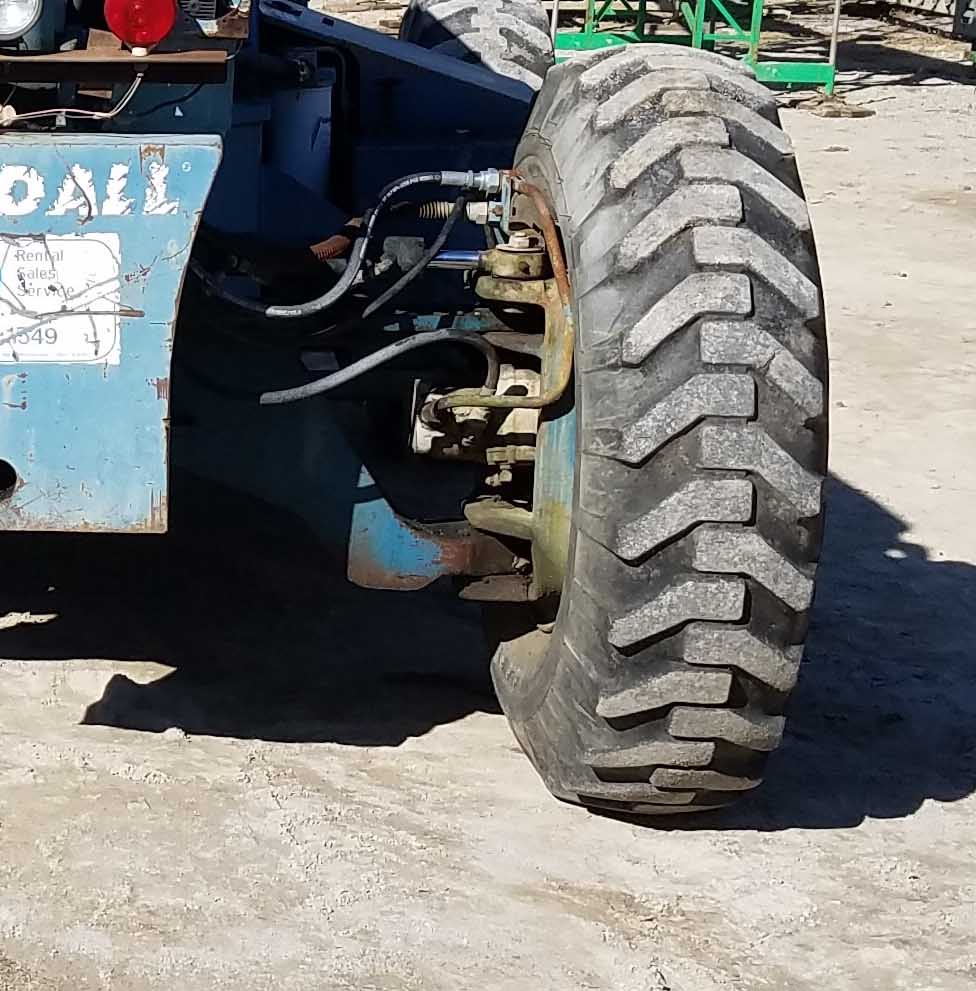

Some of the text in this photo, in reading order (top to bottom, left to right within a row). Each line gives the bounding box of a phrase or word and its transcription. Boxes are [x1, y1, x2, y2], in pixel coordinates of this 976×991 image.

[16, 249, 64, 262] Rental
[17, 269, 57, 280] Sales
[17, 283, 75, 297] Service
